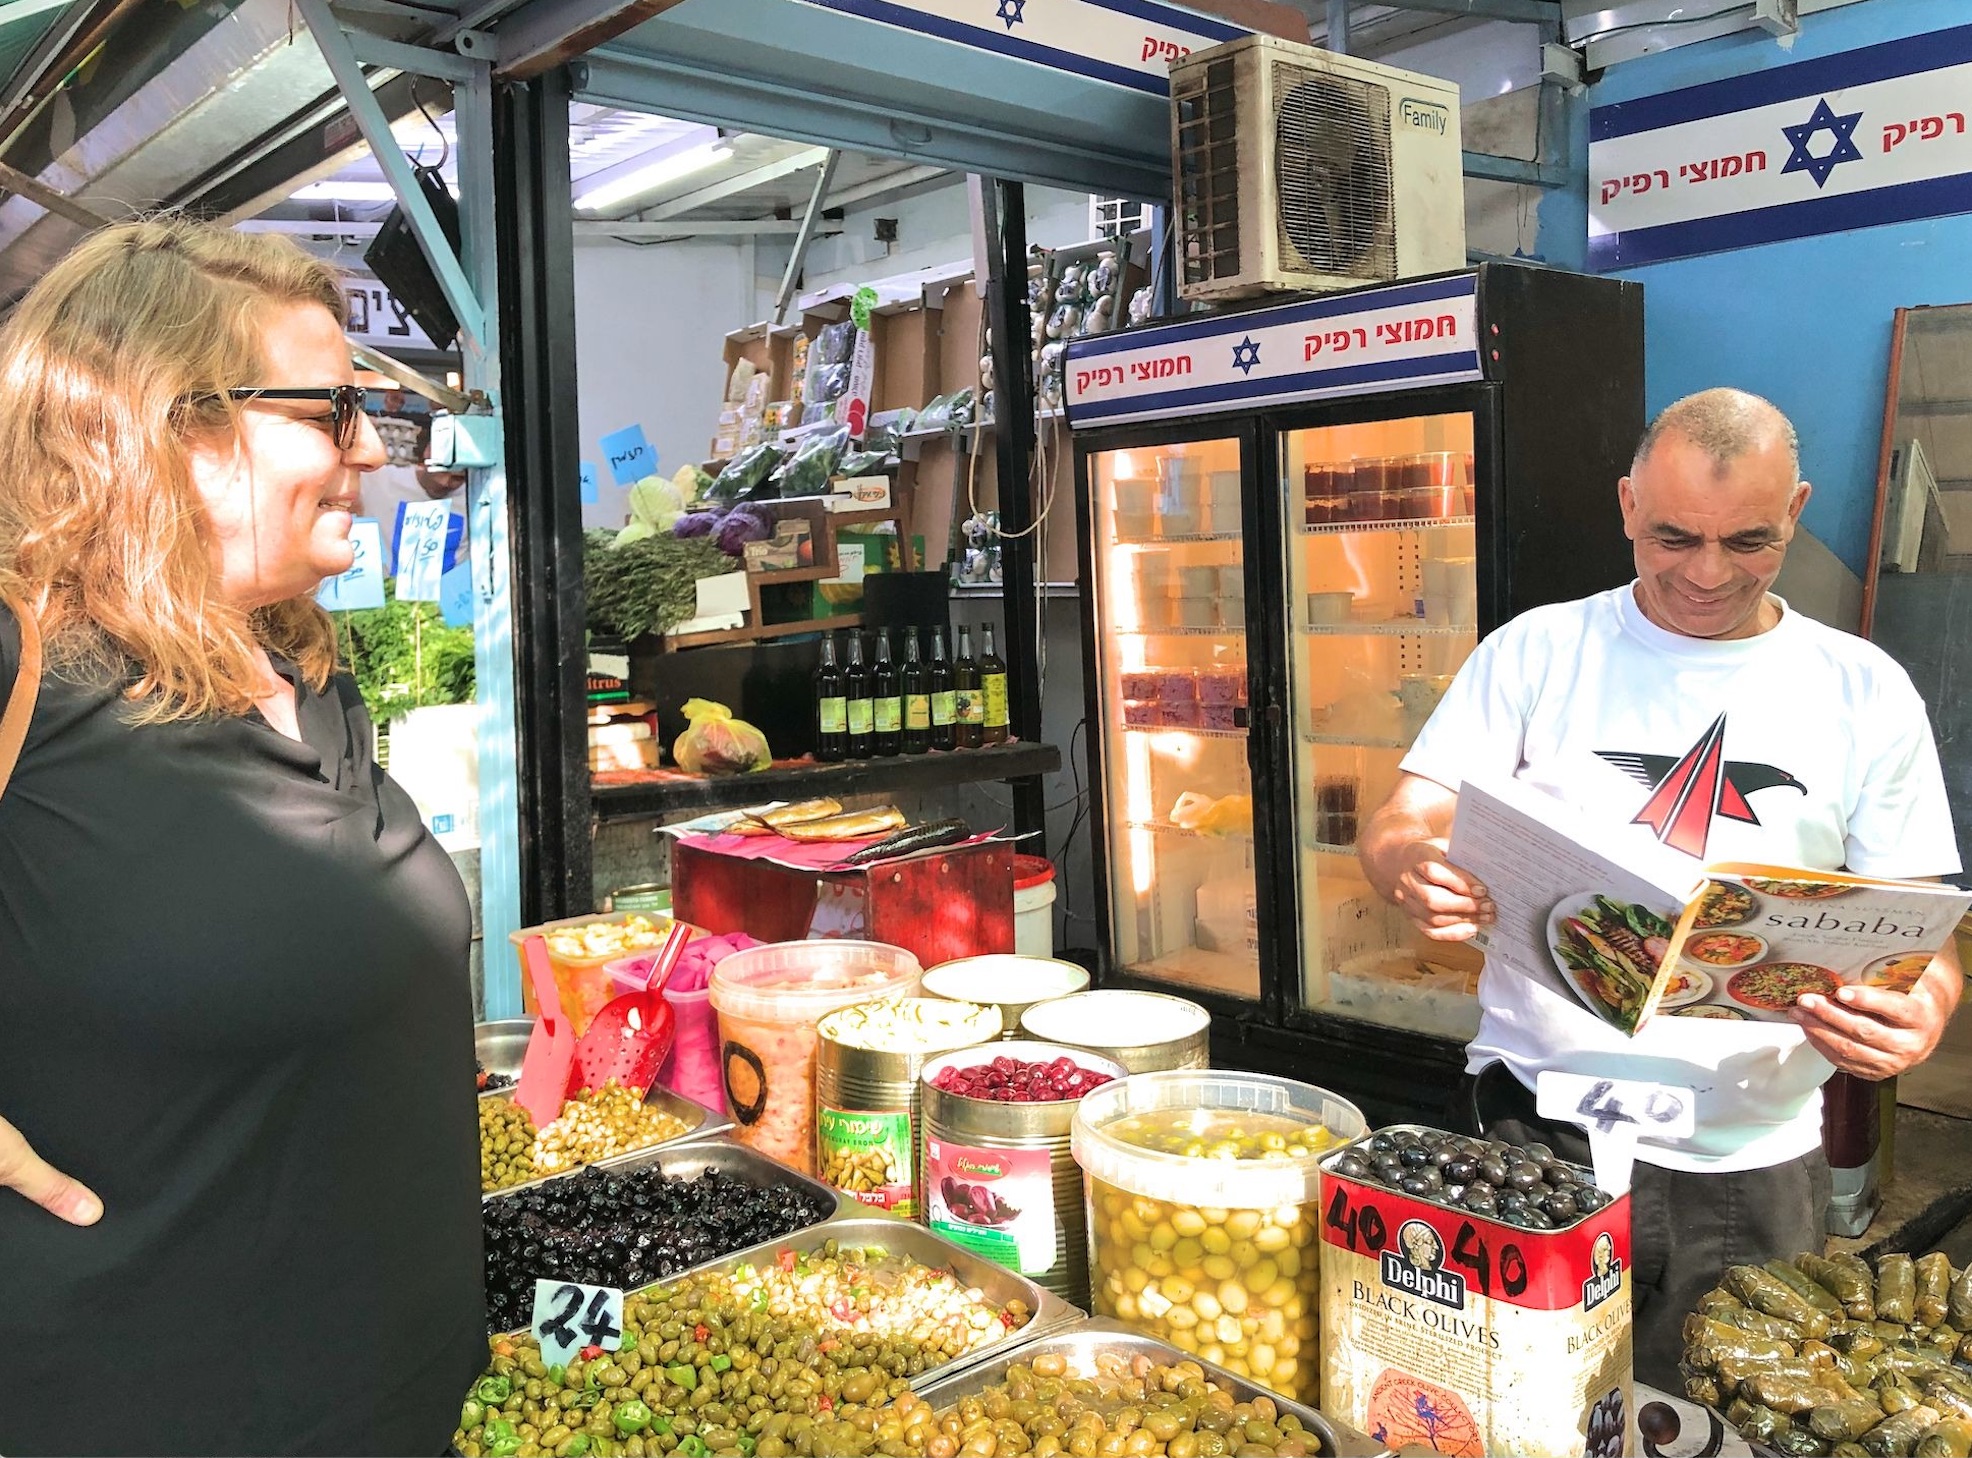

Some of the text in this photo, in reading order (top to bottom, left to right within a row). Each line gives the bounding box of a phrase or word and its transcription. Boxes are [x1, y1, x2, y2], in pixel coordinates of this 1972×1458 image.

[1404, 104, 1447, 136] Family
[1883, 112, 1966, 154] רפיק
[1601, 150, 1767, 206] חמוצי רפיק
[1304, 314, 1456, 361] חמוצי רפיק
[1076, 355, 1192, 395] חמוצי רפיק
[586, 677, 622, 690] itrus
[1765, 912, 1926, 939] sababa
[1326, 1184, 1527, 1297] 40 40
[1387, 1256, 1459, 1304] Delphi
[1586, 1266, 1620, 1306] Delphi
[540, 1285, 621, 1349] 24
[1353, 1280, 1416, 1321] BLACK
[1422, 1308, 1500, 1350] OLIVES
[1465, 1342, 1504, 1361] PROCT
[1567, 1323, 1603, 1354] BLACK
